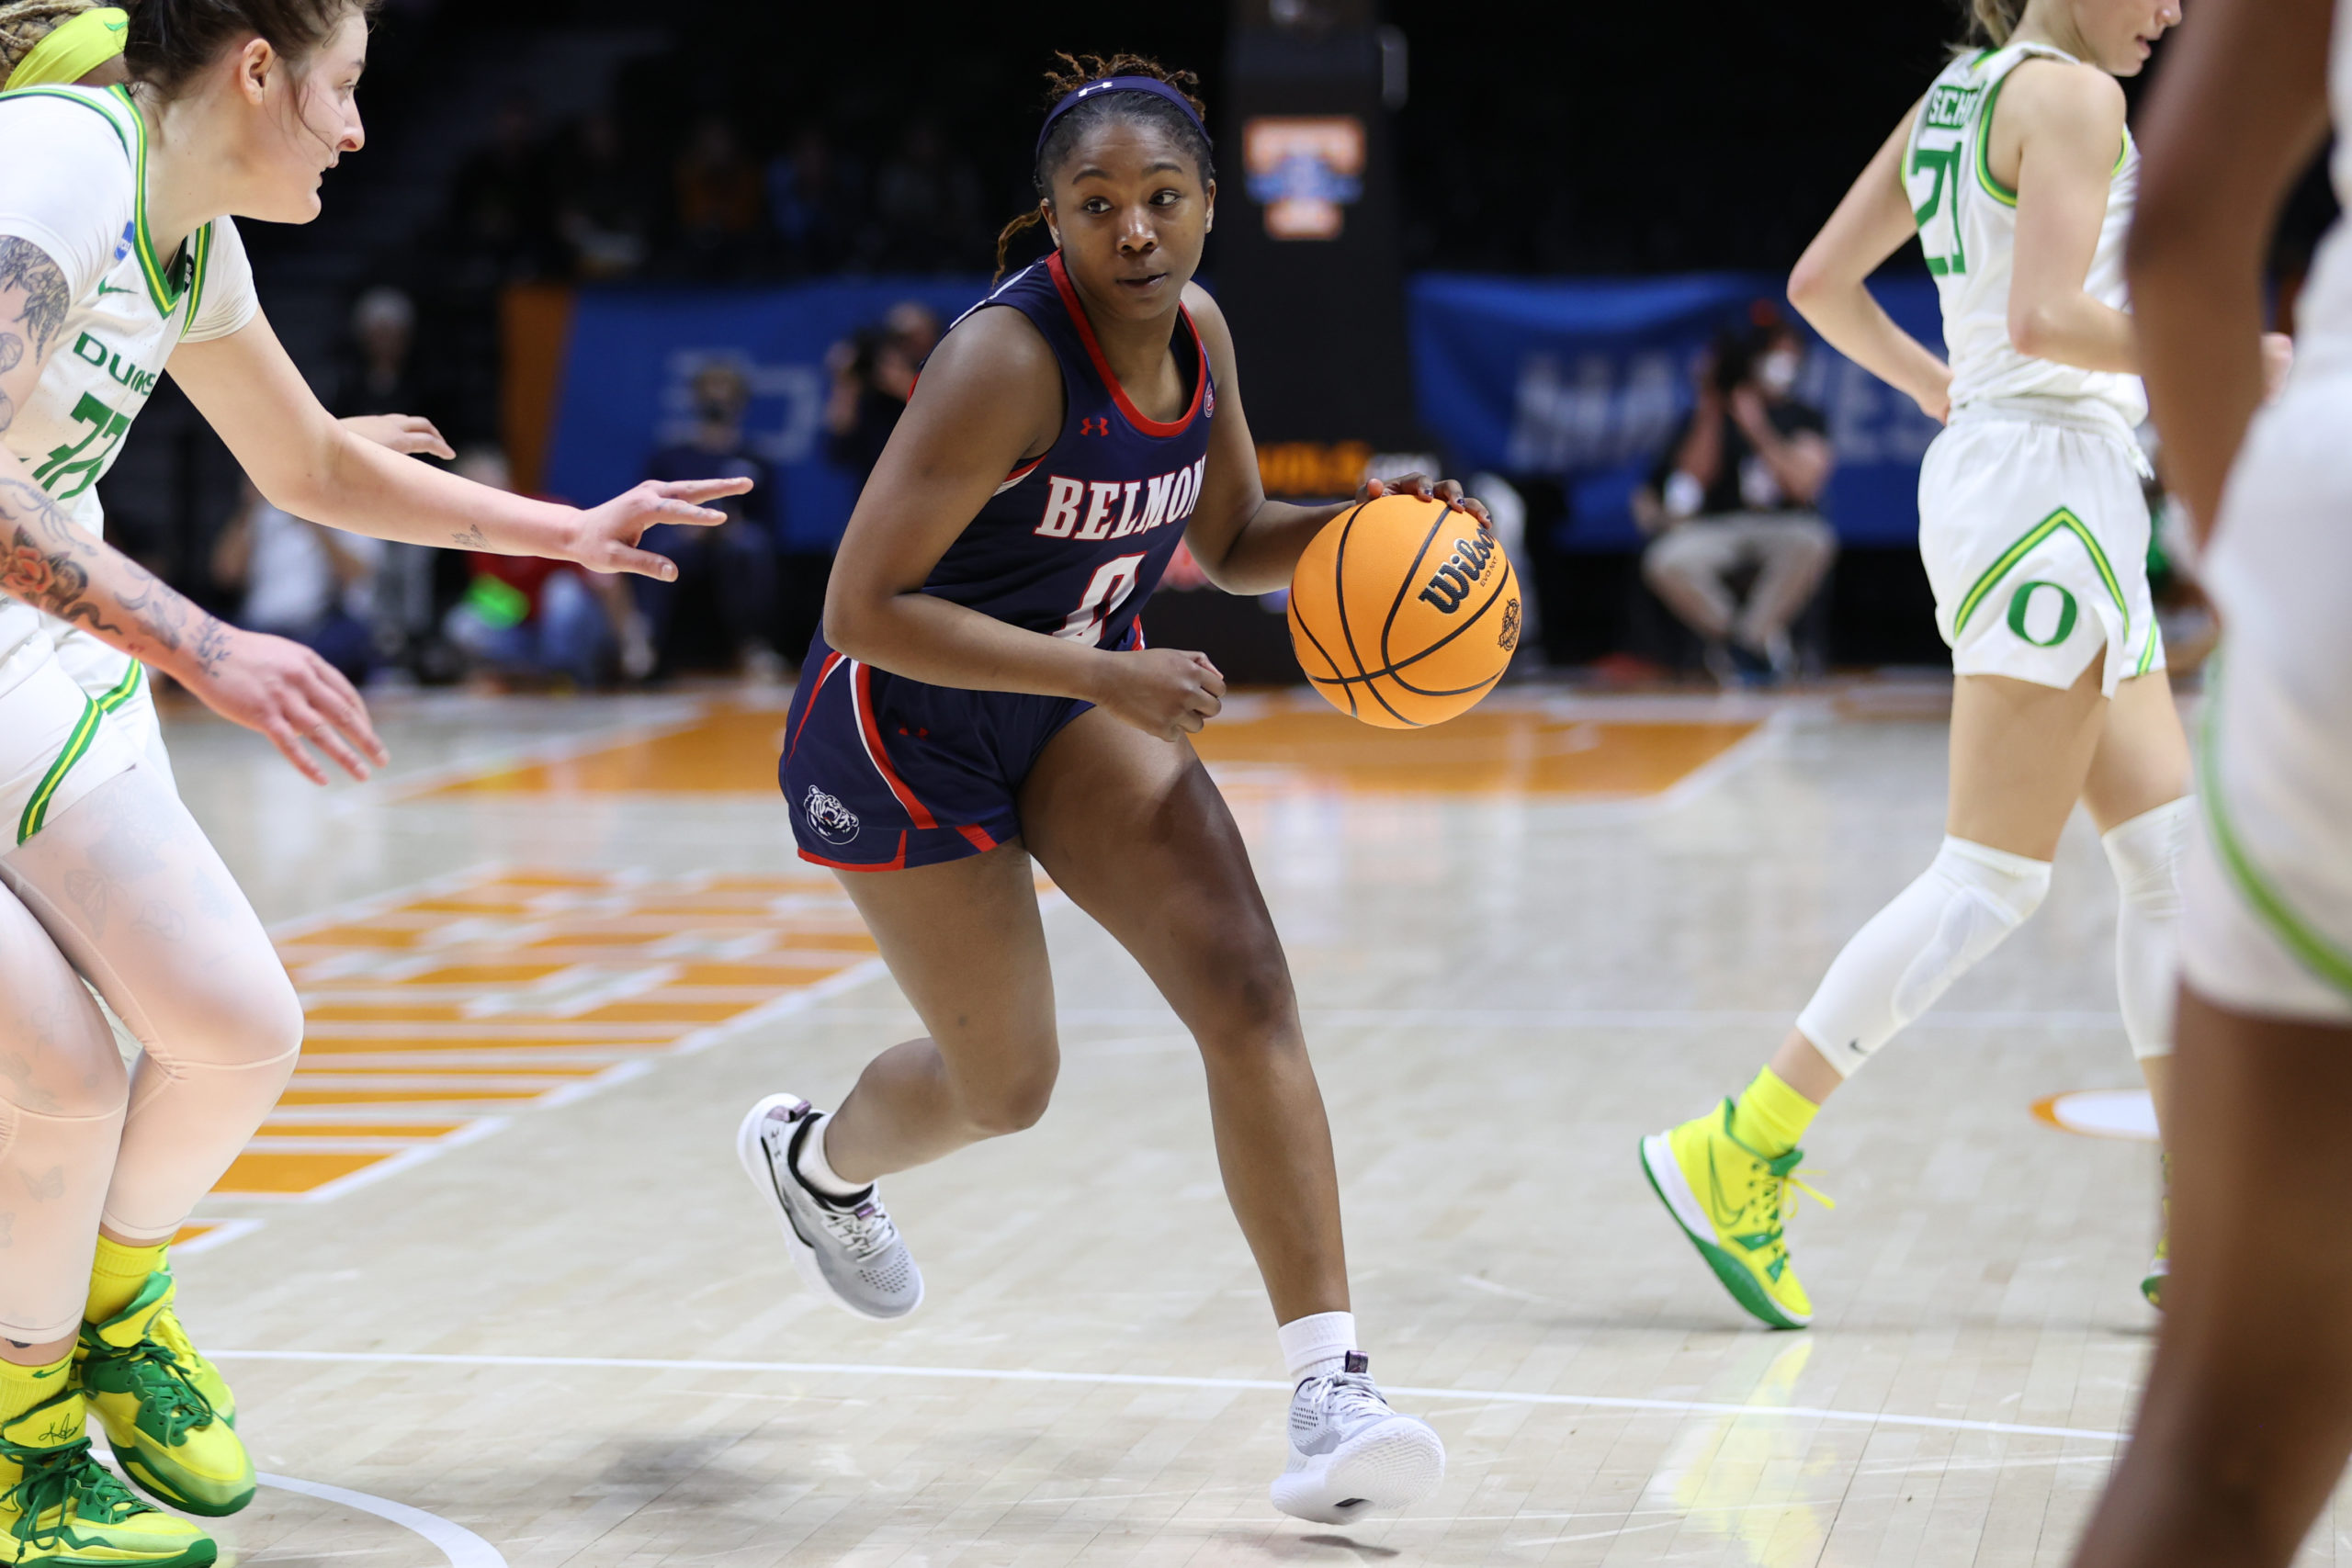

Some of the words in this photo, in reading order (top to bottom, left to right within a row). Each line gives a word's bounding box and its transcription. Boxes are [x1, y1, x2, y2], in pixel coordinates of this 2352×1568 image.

[1911, 141, 1966, 276] 21
[1033, 452, 1206, 540] BELMON
[2007, 581, 2077, 647] O
